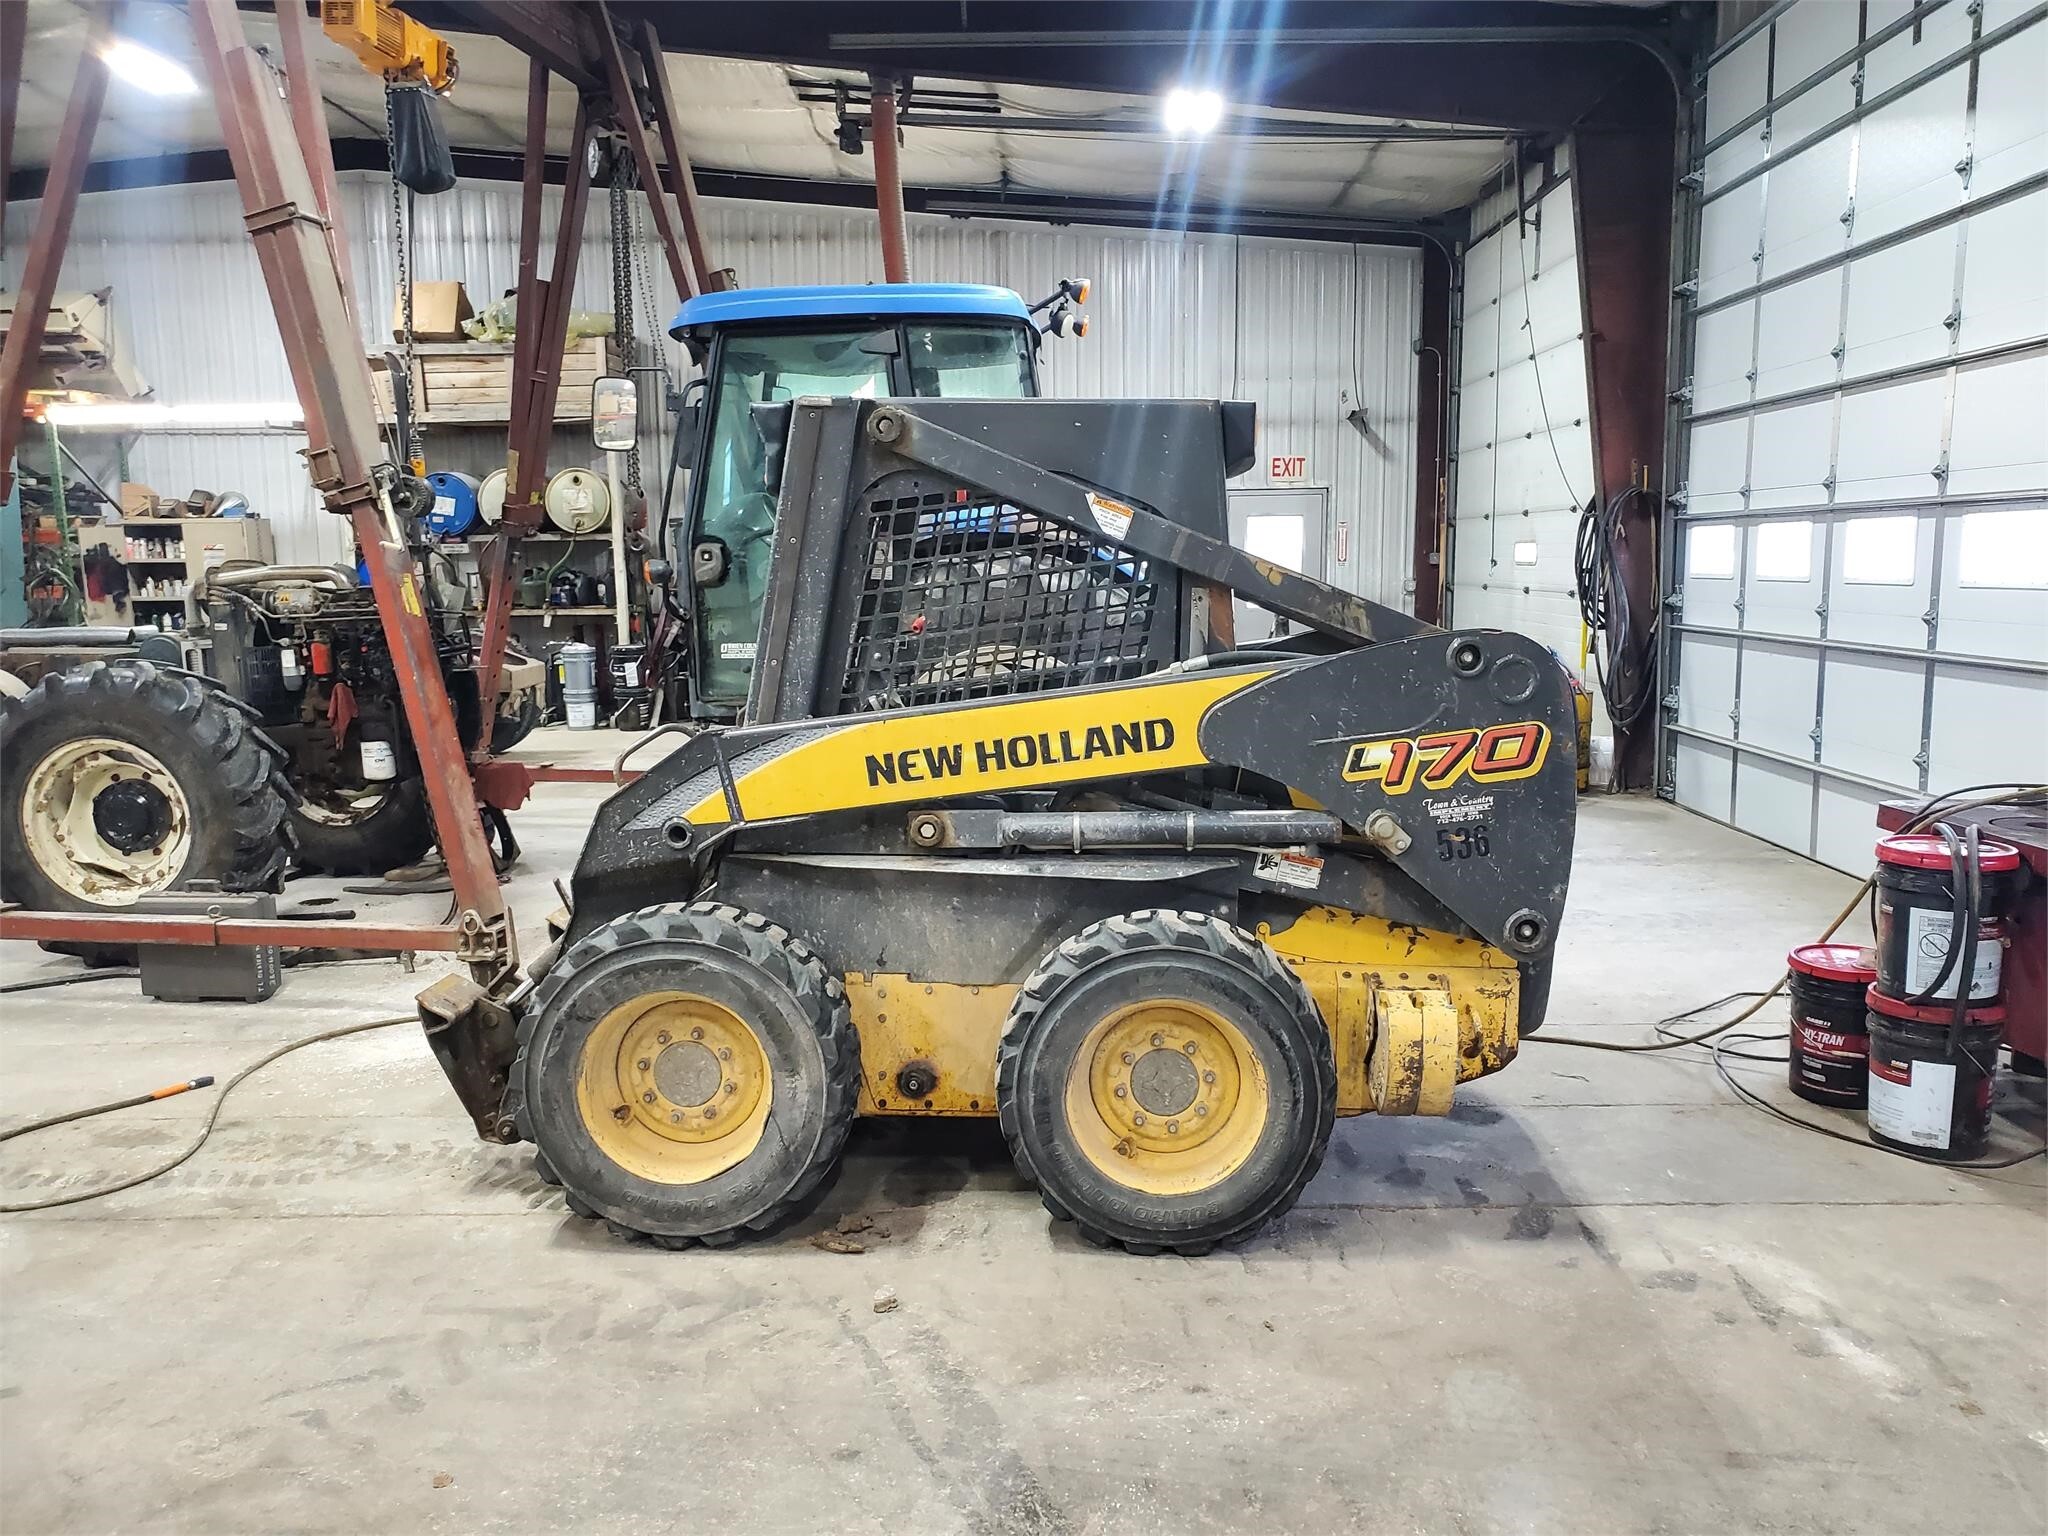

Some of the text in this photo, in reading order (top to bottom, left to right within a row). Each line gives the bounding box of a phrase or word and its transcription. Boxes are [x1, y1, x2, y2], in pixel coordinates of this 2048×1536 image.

[1272, 457, 1306, 477] EXIT
[864, 717, 1176, 787] NEW HOLLAND
[1344, 723, 1549, 792] L170
[1422, 794, 1494, 811] Town & Country
[1436, 813, 1483, 825] 712-476-2731
[1436, 825, 1490, 861] 536
[1804, 1027, 1845, 1047] HY-TRAN
[1132, 1201, 1223, 1224] GUARD
